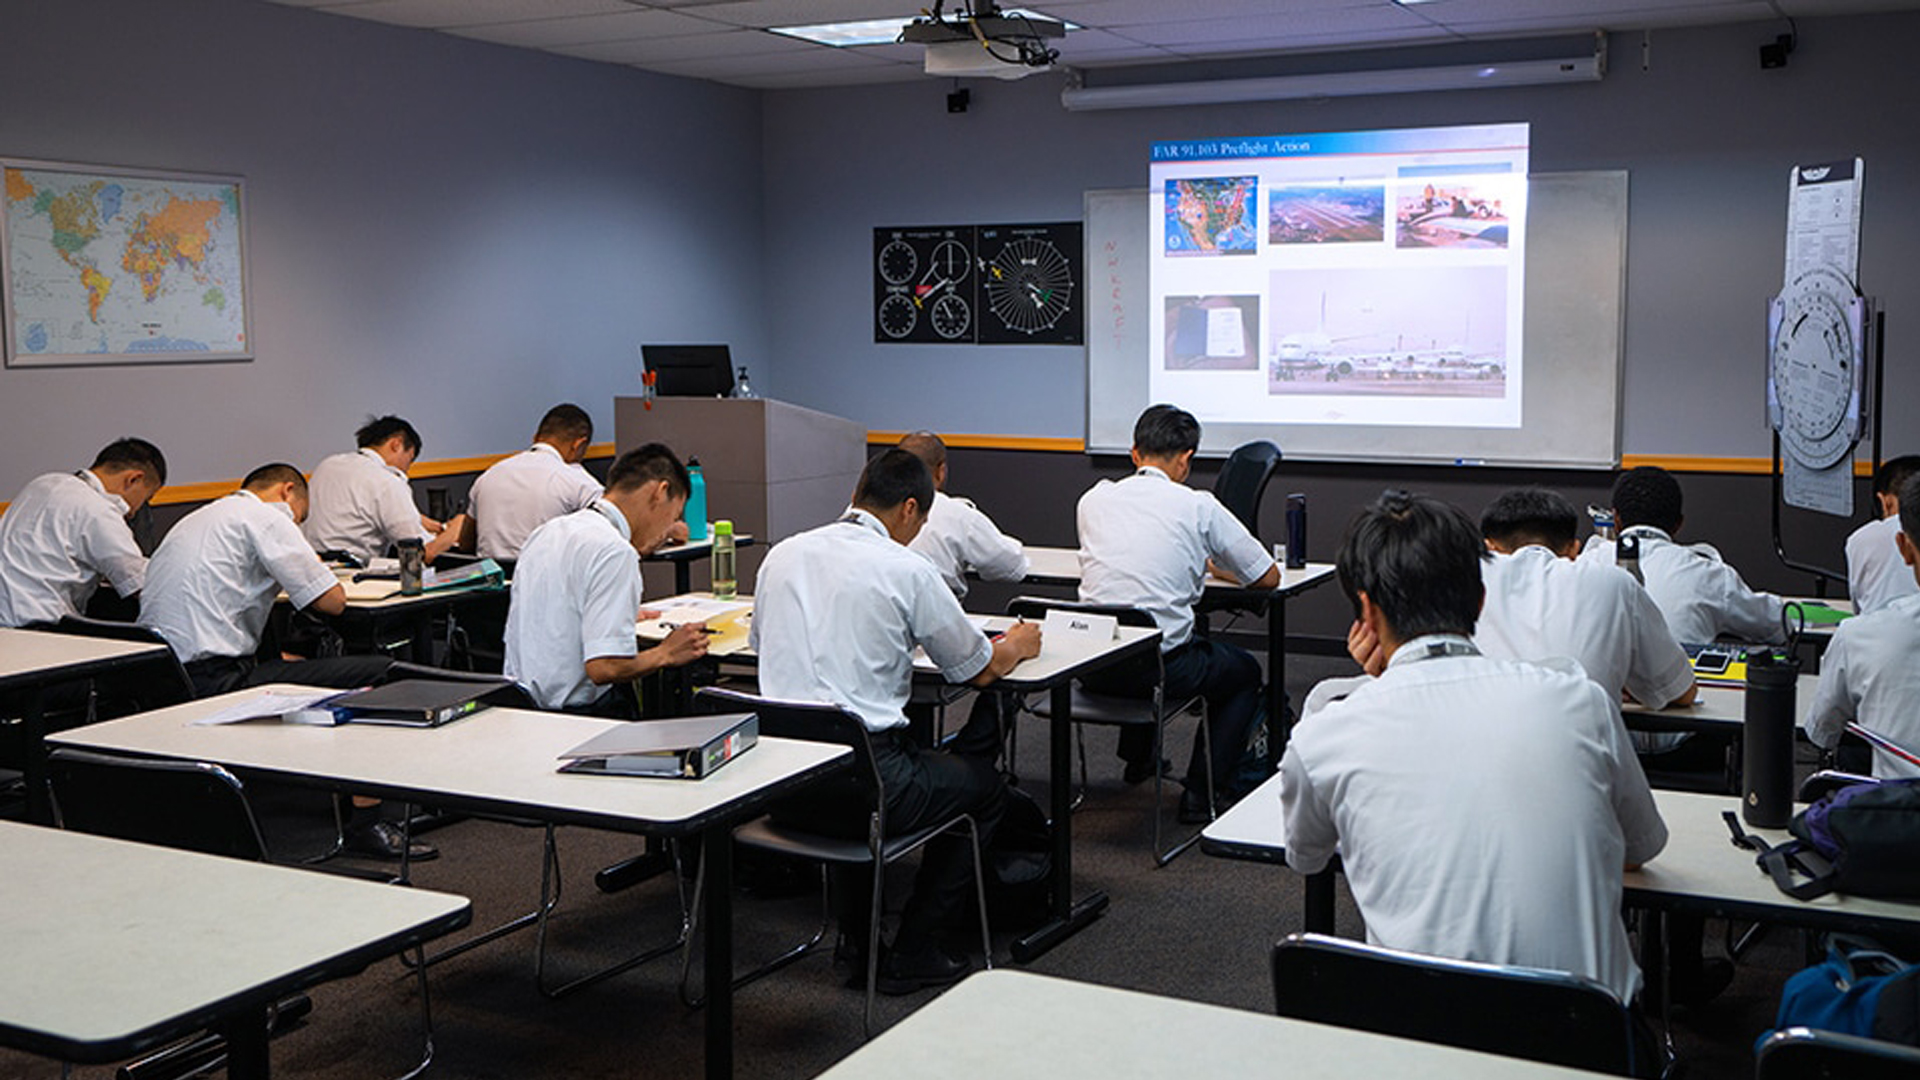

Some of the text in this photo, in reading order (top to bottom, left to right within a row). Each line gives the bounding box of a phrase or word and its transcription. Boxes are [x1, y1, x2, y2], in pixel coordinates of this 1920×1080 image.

[1153, 140, 1311, 158] FAR 91.103 Preflight Action
[1069, 620, 1089, 630] Alan
